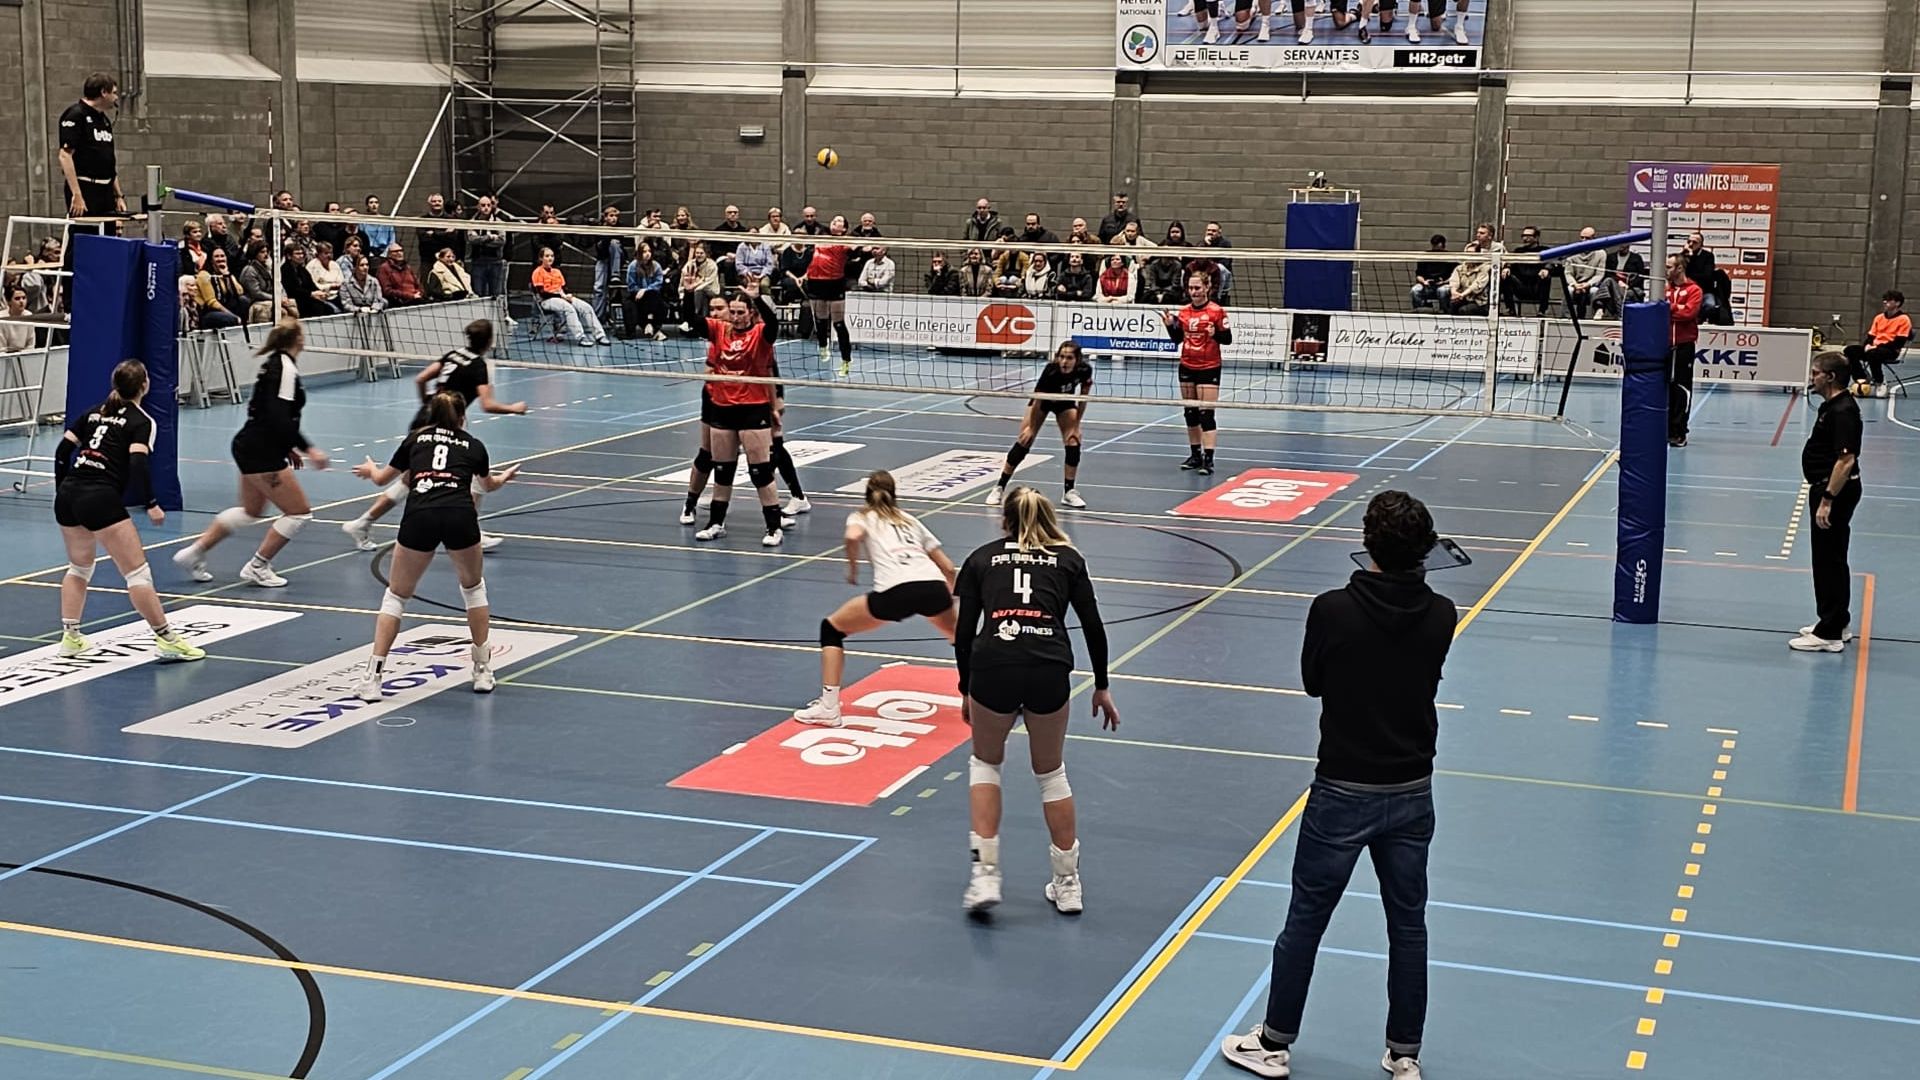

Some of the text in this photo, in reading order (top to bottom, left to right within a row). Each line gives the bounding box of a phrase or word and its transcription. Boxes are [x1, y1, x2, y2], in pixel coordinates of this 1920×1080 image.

[1175, 48, 1249, 61] DE MELLE
[1283, 50, 1360, 61] SERVANTES
[1408, 52, 1466, 64] HR2getr
[1673, 173, 1729, 190] SERVANTES
[850, 315, 972, 333] Van Oerle Interieur
[1071, 312, 1155, 333] Pauwels
[1109, 339, 1176, 351] Verzekeringen
[1709, 332, 1759, 347] 71 80
[1695, 349, 1758, 367] KKE
[1702, 369, 1757, 380] RITY
[431, 444, 449, 470] 8
[1216, 478, 1329, 508] lotto
[1013, 568, 1033, 604] 4
[0, 620, 231, 693] SEVANTE
[779, 690, 964, 766] lotto
